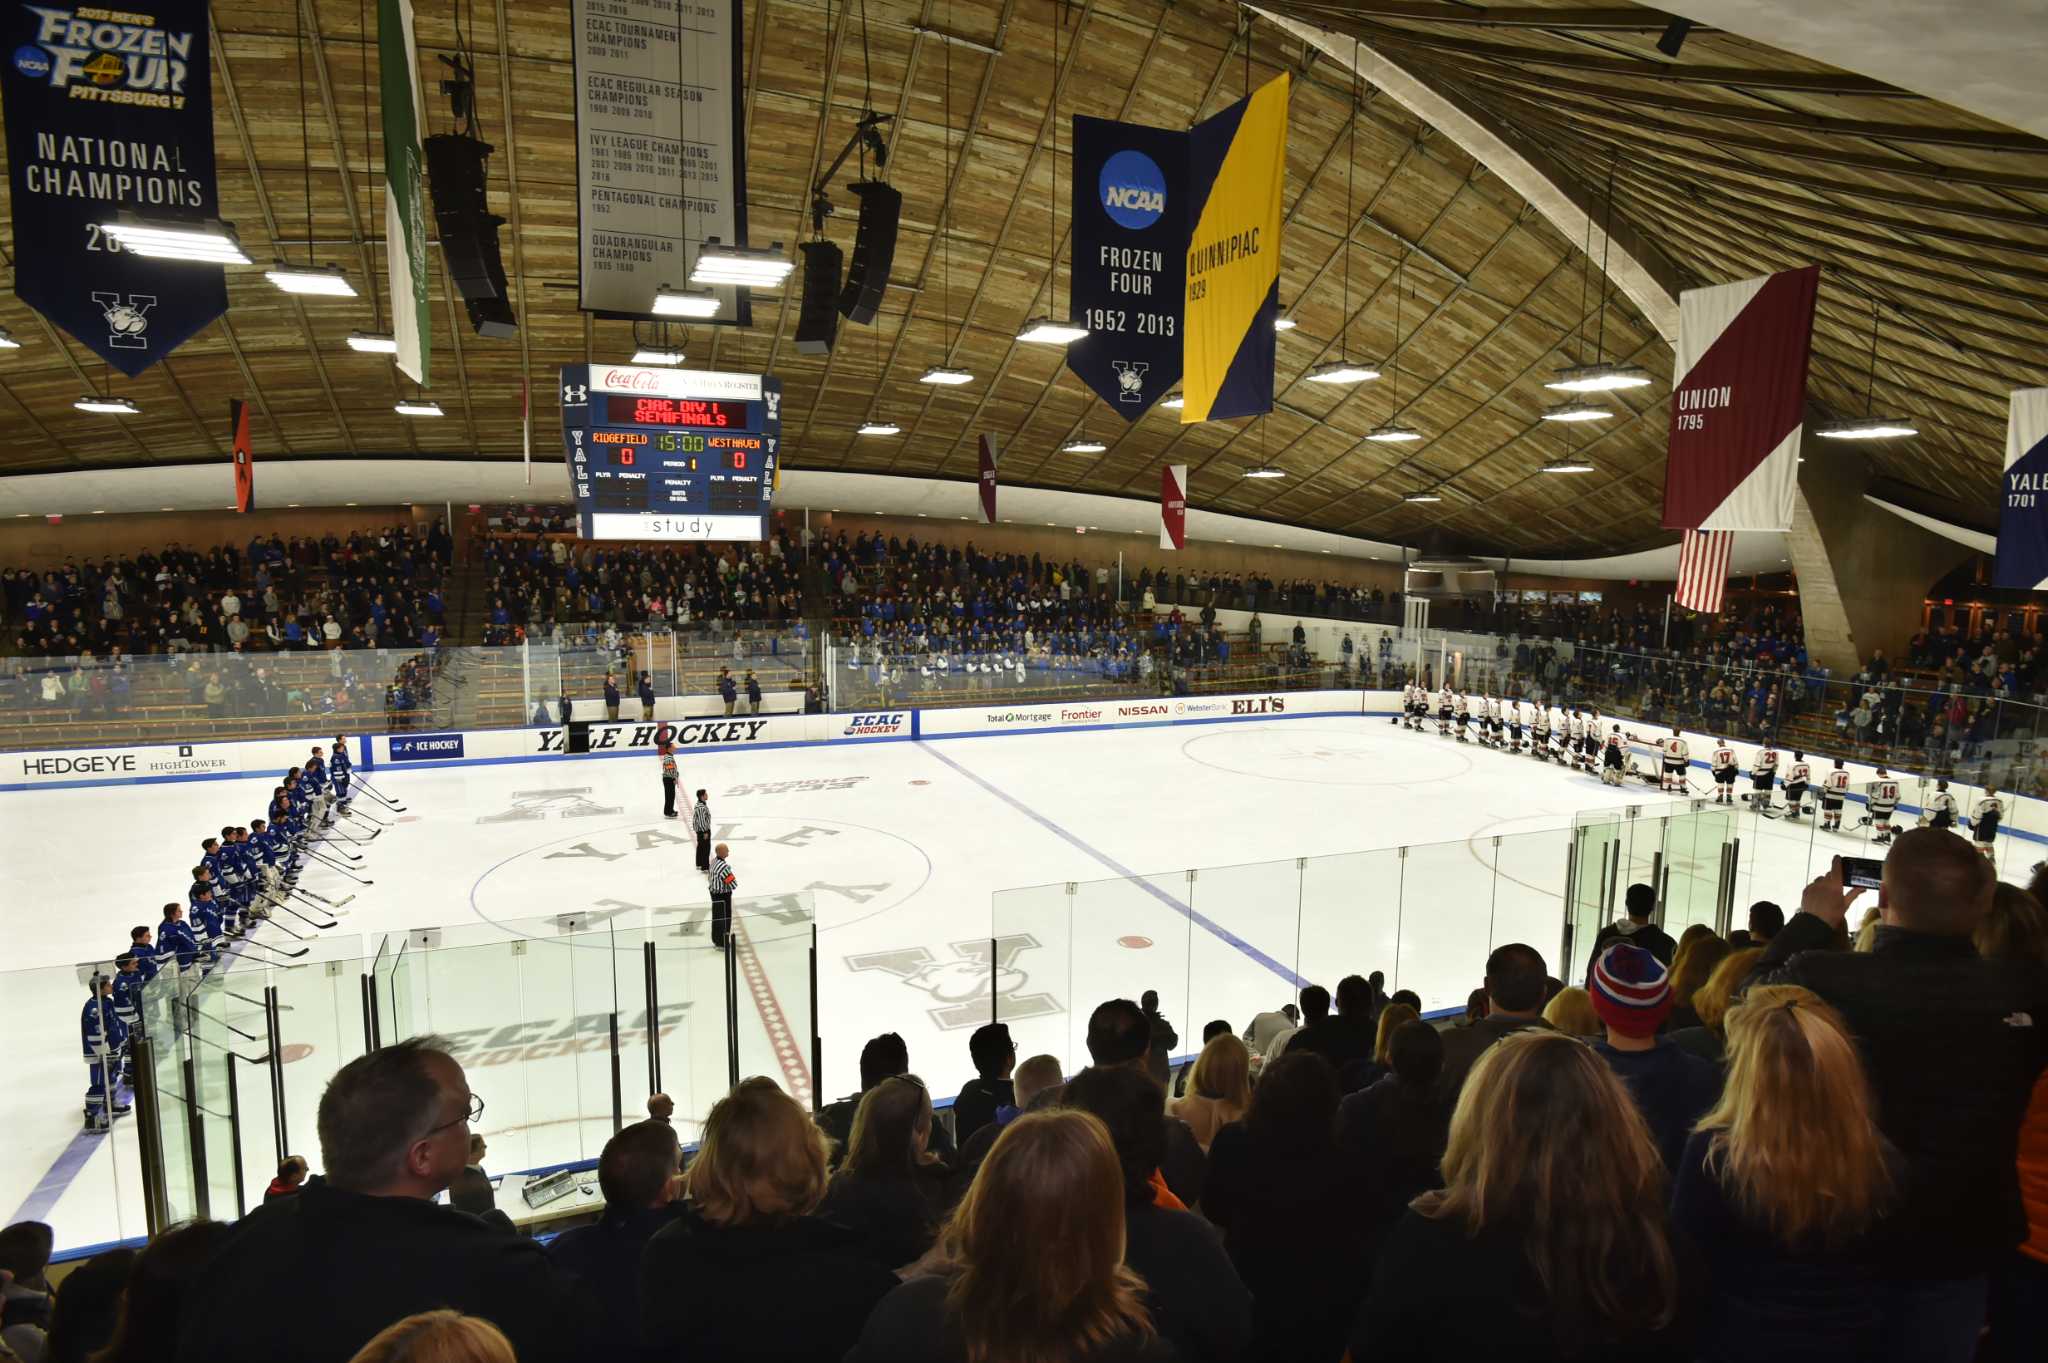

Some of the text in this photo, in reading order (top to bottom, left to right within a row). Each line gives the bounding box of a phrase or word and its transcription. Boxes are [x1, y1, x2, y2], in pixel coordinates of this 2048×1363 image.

[111, 10, 156, 26] MEN'S
[22, 4, 195, 60] FROZEN
[586, 19, 680, 42] ECAC TOURNAMENT
[587, 32, 648, 50] CHAMPIONS
[588, 76, 703, 102] ECAC REGULAR SEASON
[589, 89, 648, 106] CHAMPIONS
[37, 132, 187, 173] NATIONAL
[590, 134, 709, 159] IVY LEAGUE CHAMPIONS
[26, 164, 203, 207] CHAMPIONS
[592, 189, 717, 214] PENTAGONAL CHAMPIONS
[1106, 186, 1164, 214] NCAA
[592, 235, 673, 253] QUADRANGULAR
[1190, 227, 1260, 277] QUINNIPIAC
[592, 248, 652, 262] CHAMPIONS
[1100, 246, 1162, 272] FROZEN
[1110, 272, 1152, 295] FOUR
[1189, 280, 1206, 301] 1929
[1085, 309, 1175, 337] 1952 2013
[680, 401, 707, 413] DIV
[1679, 386, 1731, 411] UNION
[635, 411, 727, 426] SEMIFINALS
[1678, 414, 1703, 430] 1795
[593, 433, 648, 445] RIDGEFIELD
[659, 435, 704, 452] 15:00
[571, 430, 590, 498] YALE
[621, 448, 745, 468] 0 0
[763, 439, 777, 501] YALE
[2010, 473, 2048, 491] YALE
[2008, 494, 2035, 507] 1701
[653, 517, 713, 538] study
[1061, 709, 1102, 720] Frontier
[1118, 705, 1168, 716] NISSAN
[1231, 696, 1285, 714] ELI'S
[852, 714, 904, 726] ECAC
[987, 714, 1005, 722] Total
[1015, 713, 1052, 723] Mortgage
[629, 720, 767, 748] HOCKEY
[855, 725, 899, 735] HOCKEY
[416, 739, 459, 751] ICE HOCKEY
[1670, 742, 1677, 752] 4
[23, 754, 136, 776] HEDGEYE
[149, 758, 227, 771] HIGHTOWER
[1882, 785, 1897, 799] 19
